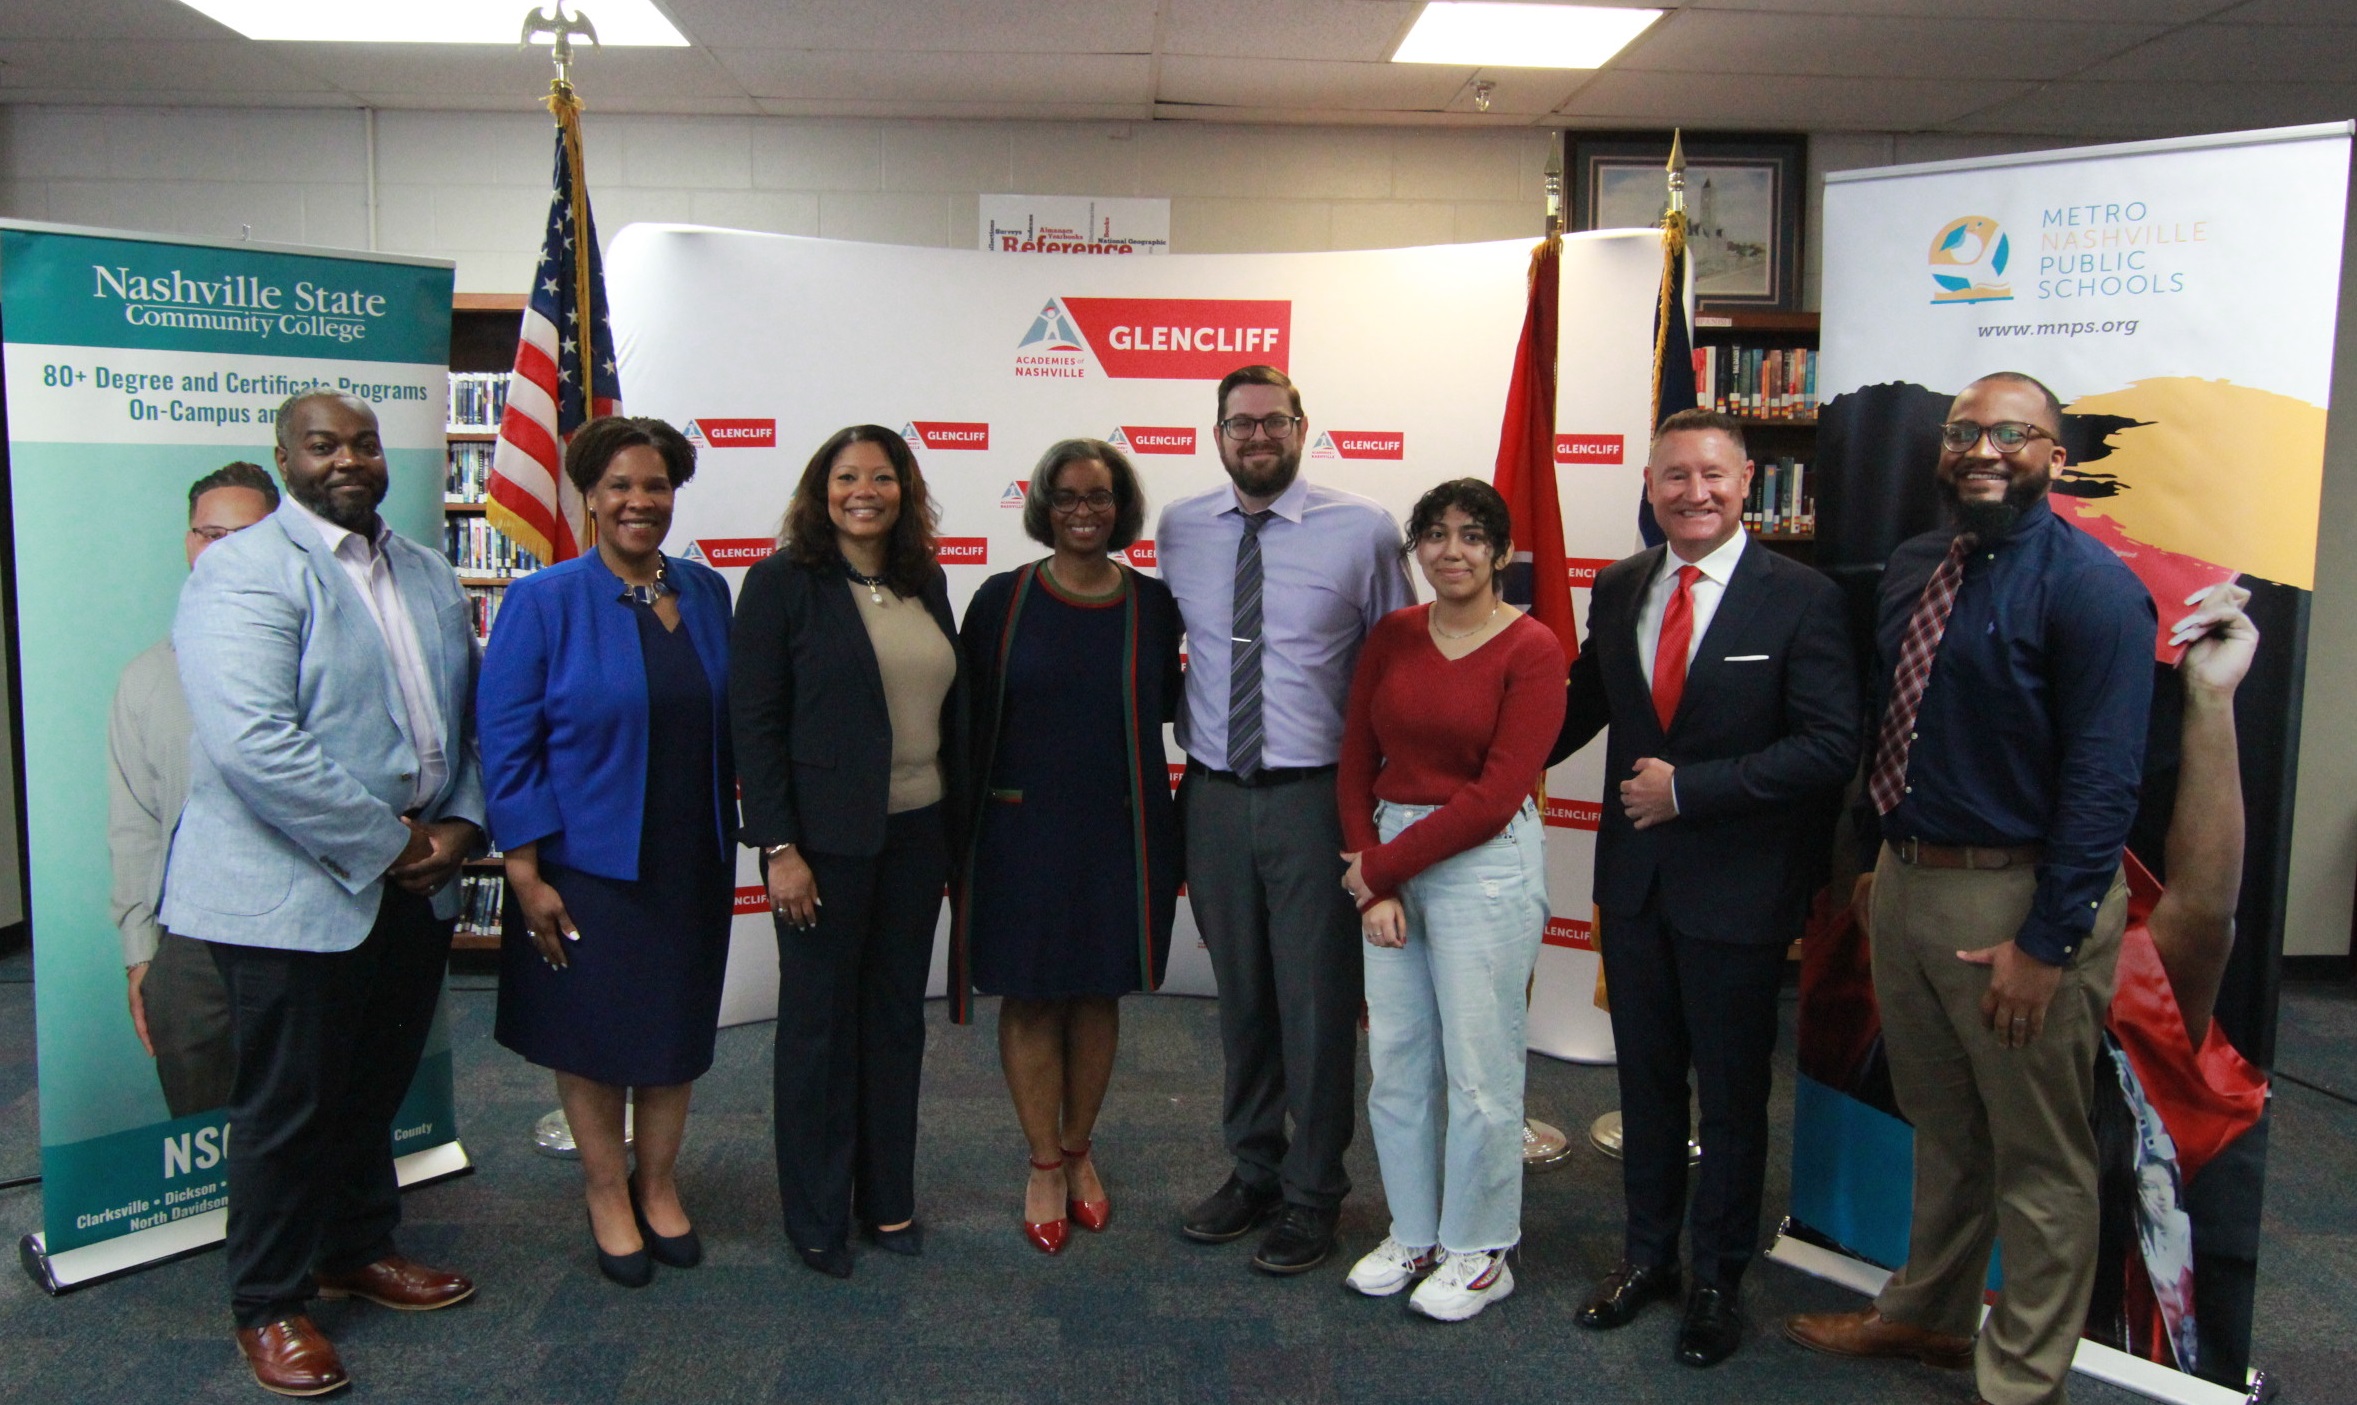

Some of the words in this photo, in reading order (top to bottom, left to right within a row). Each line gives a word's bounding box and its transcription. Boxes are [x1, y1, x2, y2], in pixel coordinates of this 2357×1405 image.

[2042, 201, 2147, 228] METRO
[995, 228, 1023, 236] Surveys
[2041, 221, 2208, 251] NASHVILLE
[1002, 235, 1133, 254] Reference
[1097, 237, 1127, 245] National
[1128, 238, 1167, 246] Geographic
[2040, 250, 2146, 276] PUBLIC
[92, 264, 283, 310] Nashville
[295, 281, 387, 317] State
[2038, 272, 2184, 300] SCHOOLS
[125, 303, 274, 339] Community
[279, 314, 366, 343] College
[1977, 319, 2140, 338] www.mnps.org
[1108, 325, 1280, 353] GLENCLIFF
[1016, 356, 1076, 366] ACADEMIES
[1015, 367, 1085, 378] NASHVILLE
[43, 364, 87, 388] 80+
[95, 366, 174, 395] Degree
[181, 371, 219, 393] and
[338, 377, 428, 403] Programs
[129, 399, 251, 427] On-Campus
[257, 407, 278, 424] an
[711, 428, 773, 438] GLENCLIFF
[927, 431, 986, 442] GLENCLIFF
[1135, 435, 1193, 446] GLENCLIFF
[1342, 440, 1400, 451] GLENCLIFF
[1556, 443, 1621, 455] GLENCLIFF
[712, 547, 773, 559] GLENCLIFF
[938, 546, 985, 556] ENCLIFF
[734, 894, 769, 906] NCLIF
[1544, 926, 1591, 941] LENCLIF
[76, 1200, 150, 1230] Clarksville
[165, 1182, 217, 1206] Dickson
[394, 1122, 433, 1141] County
[130, 1211, 168, 1232] North
[171, 1196, 229, 1221] Davidson
